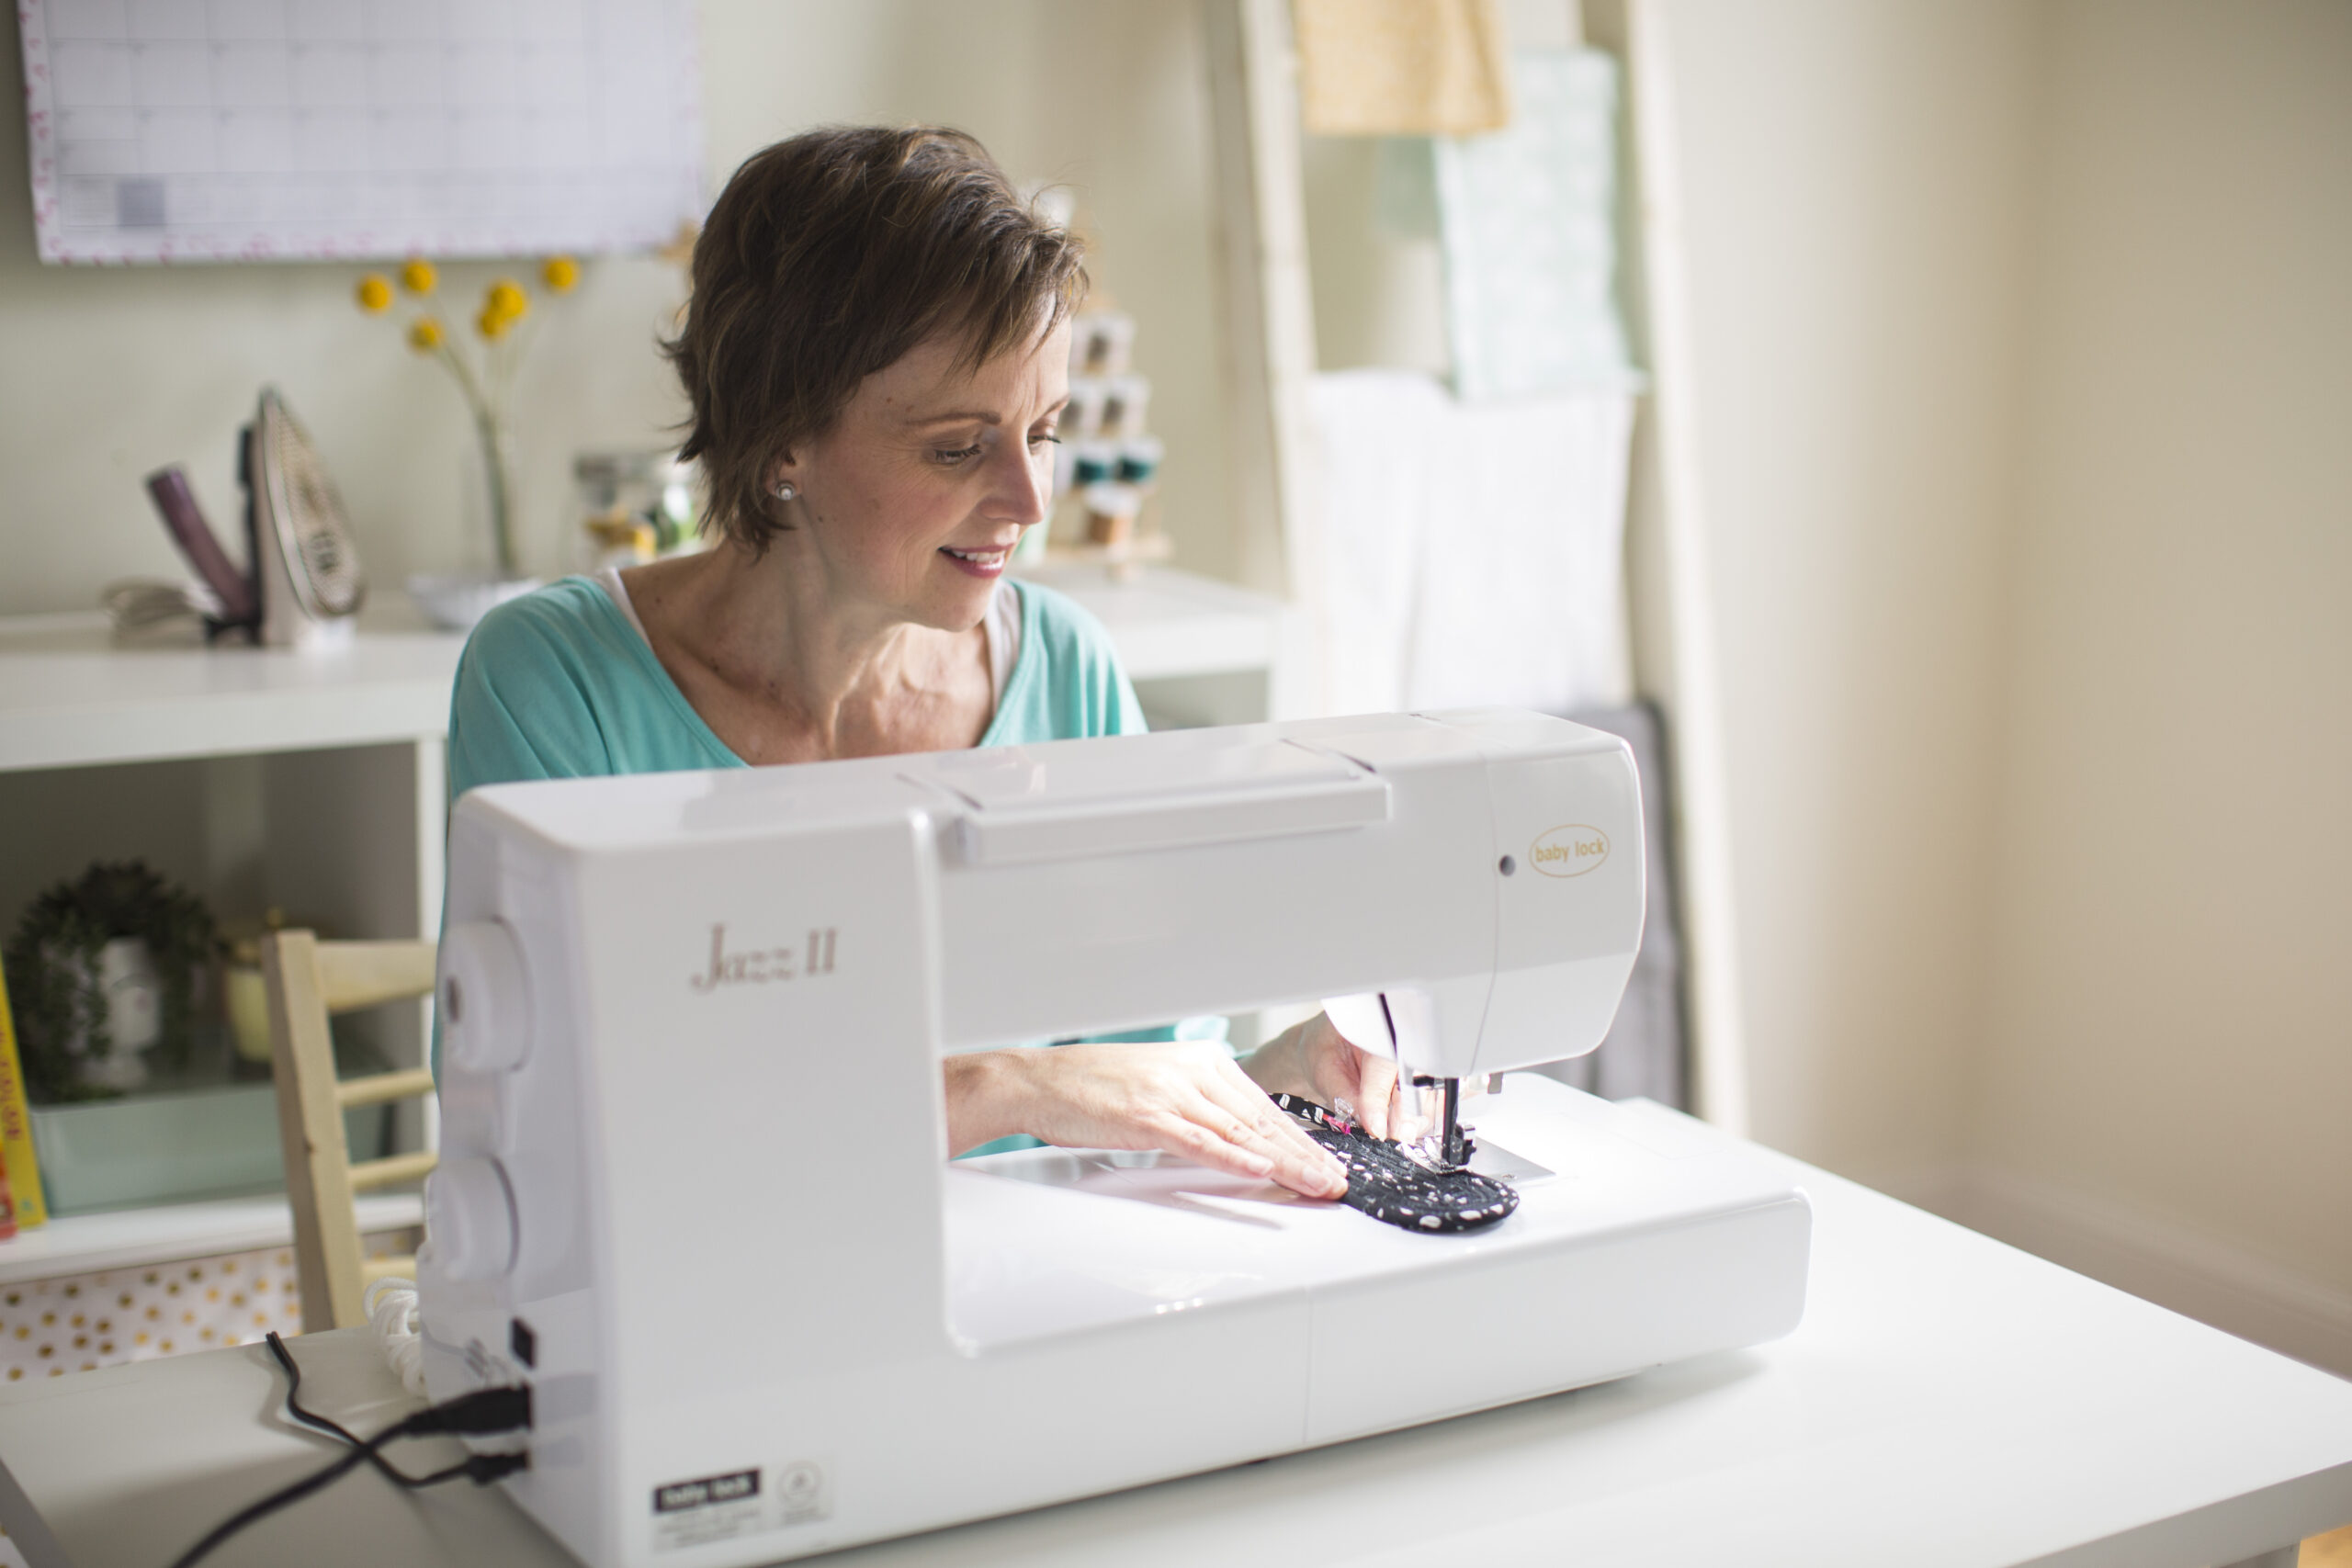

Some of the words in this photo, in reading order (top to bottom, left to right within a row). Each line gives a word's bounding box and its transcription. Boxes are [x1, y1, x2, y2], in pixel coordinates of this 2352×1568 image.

[1535, 843, 1570, 863] baby
[1575, 838, 1604, 858] lock
[691, 923, 796, 995] Jazz
[807, 929, 837, 975] II
